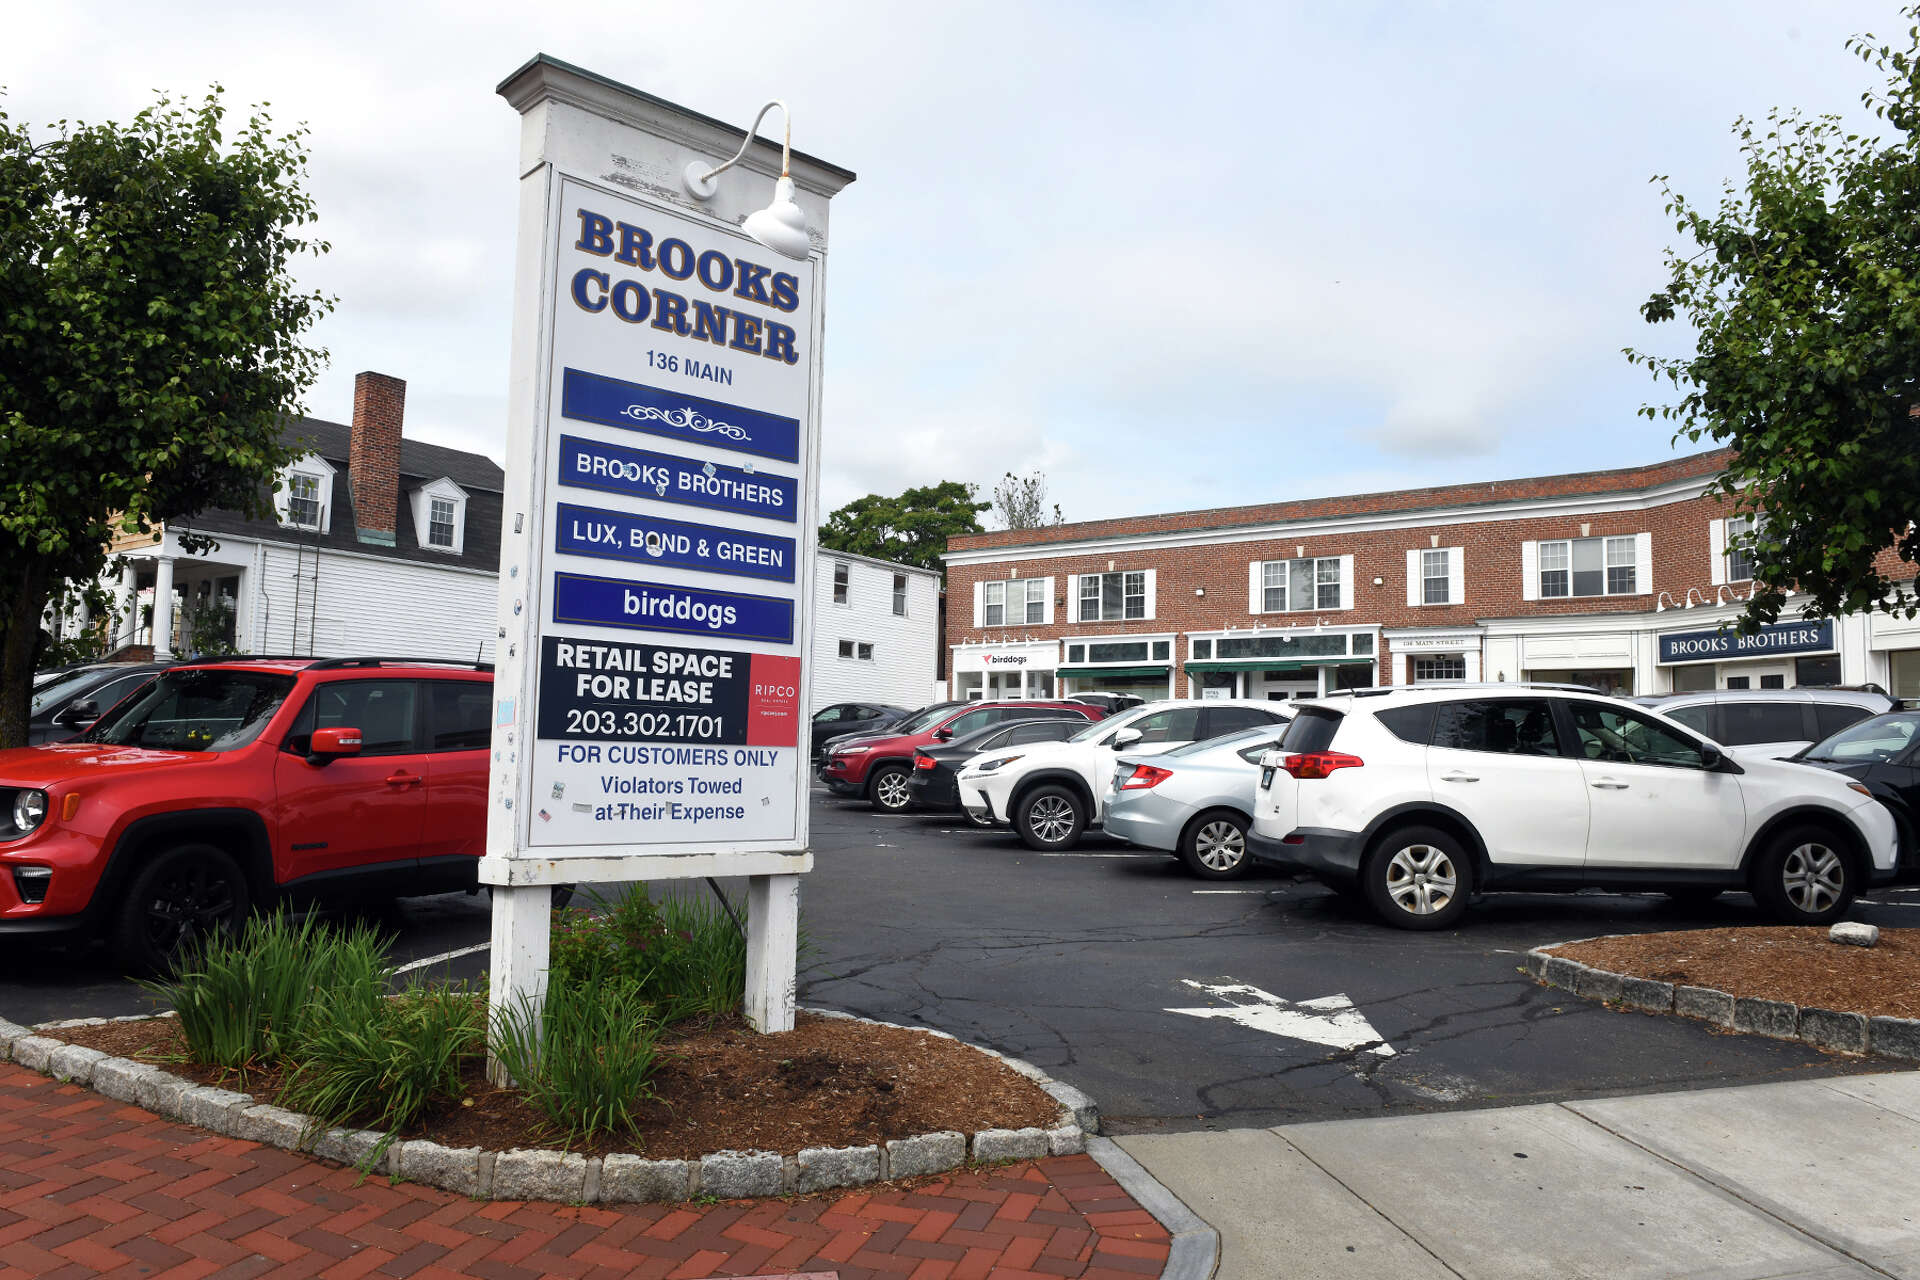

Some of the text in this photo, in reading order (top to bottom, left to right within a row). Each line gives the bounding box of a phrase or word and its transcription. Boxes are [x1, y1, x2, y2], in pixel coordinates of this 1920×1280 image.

[575, 208, 799, 313] BROOKS
[571, 267, 799, 365] CORNER
[646, 350, 733, 386] 136 MAIN
[576, 453, 784, 507] BROOKS BROTHERS
[573, 520, 783, 568] LUX, BOND & GREEN
[624, 589, 737, 628] birddogs
[1671, 629, 1819, 655] BROOKS BROTHERS
[557, 643, 733, 679] RETAIL SPACE
[992, 655, 1027, 665] birddogs
[577, 674, 713, 704] FOR LEASE
[755, 684, 795, 698] RIPCO
[566, 709, 723, 738] 203.302.1701
[558, 745, 778, 767] FOR CUSTOMERS ONLY
[601, 776, 743, 794] Violators Towed
[595, 803, 745, 824] at Their Expense
